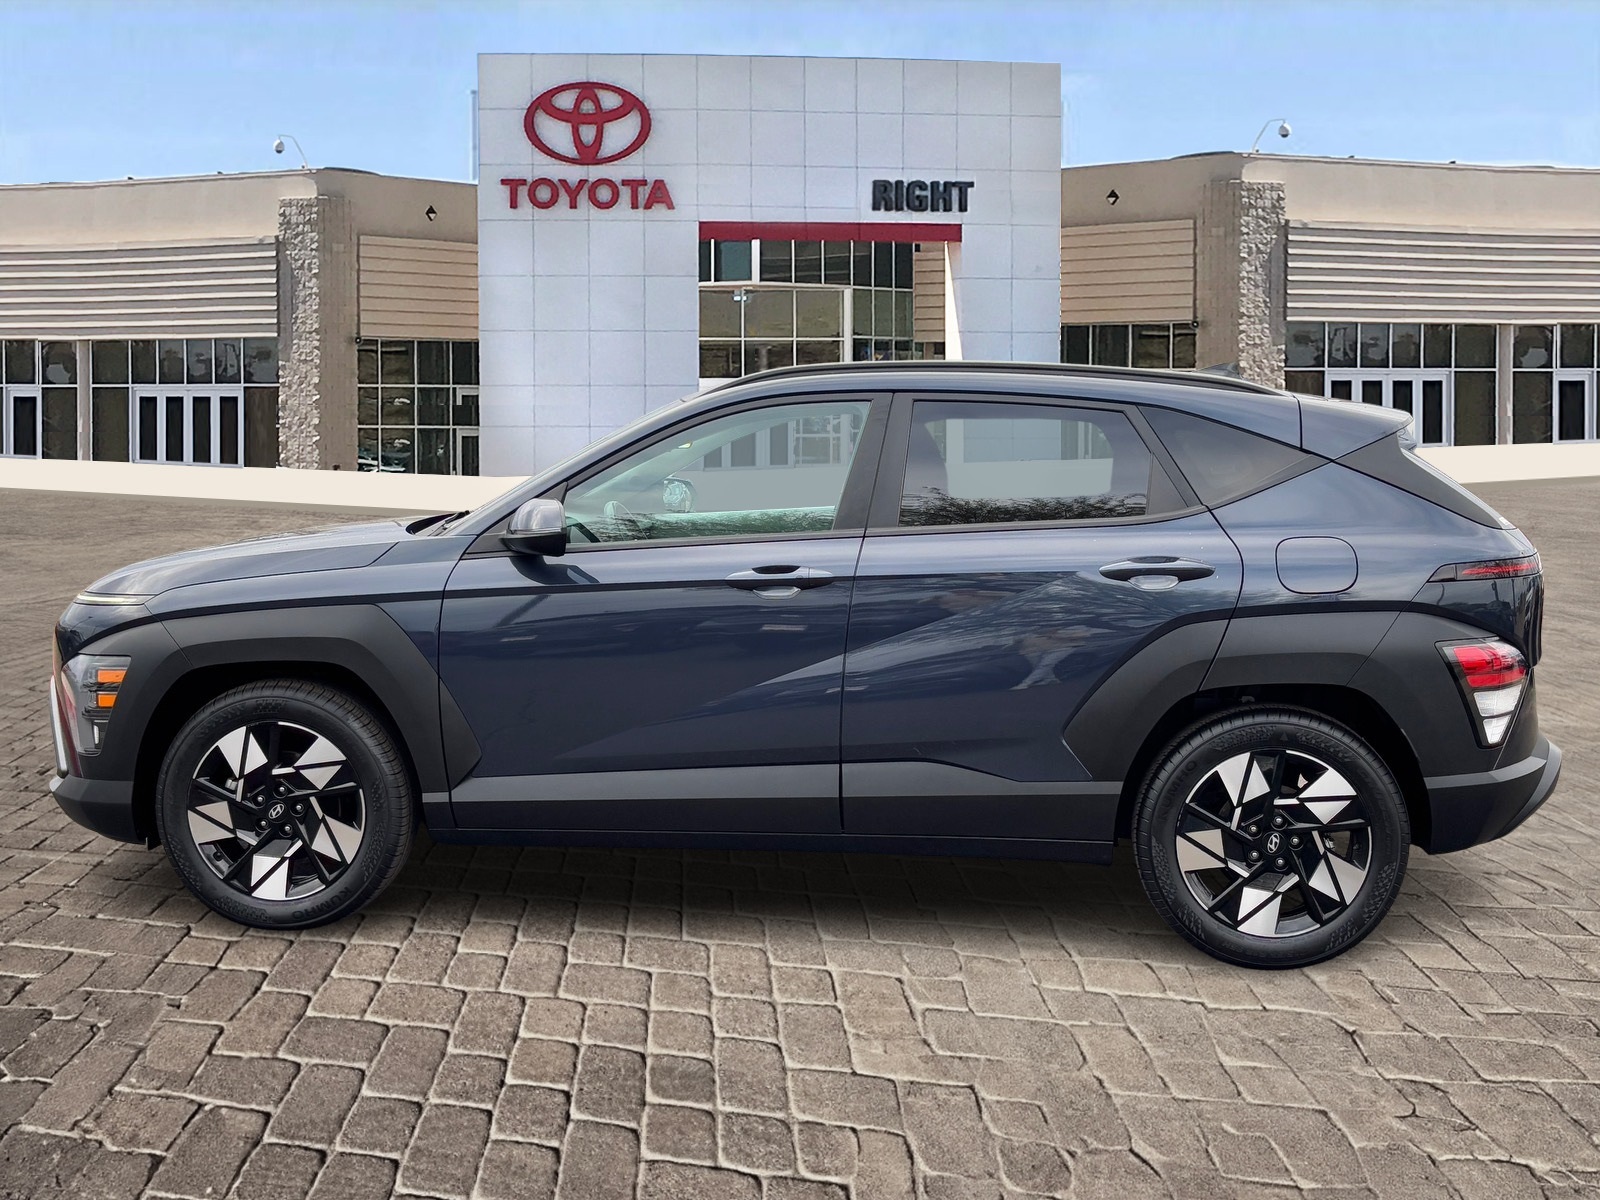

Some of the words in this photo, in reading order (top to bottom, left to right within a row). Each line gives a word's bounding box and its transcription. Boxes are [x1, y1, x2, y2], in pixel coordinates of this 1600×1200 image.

[500, 177, 676, 210] TOYOTA
[872, 179, 975, 213] RIGHT
[1157, 760, 1197, 822] KUMHO
[291, 886, 352, 919] KUMHO
